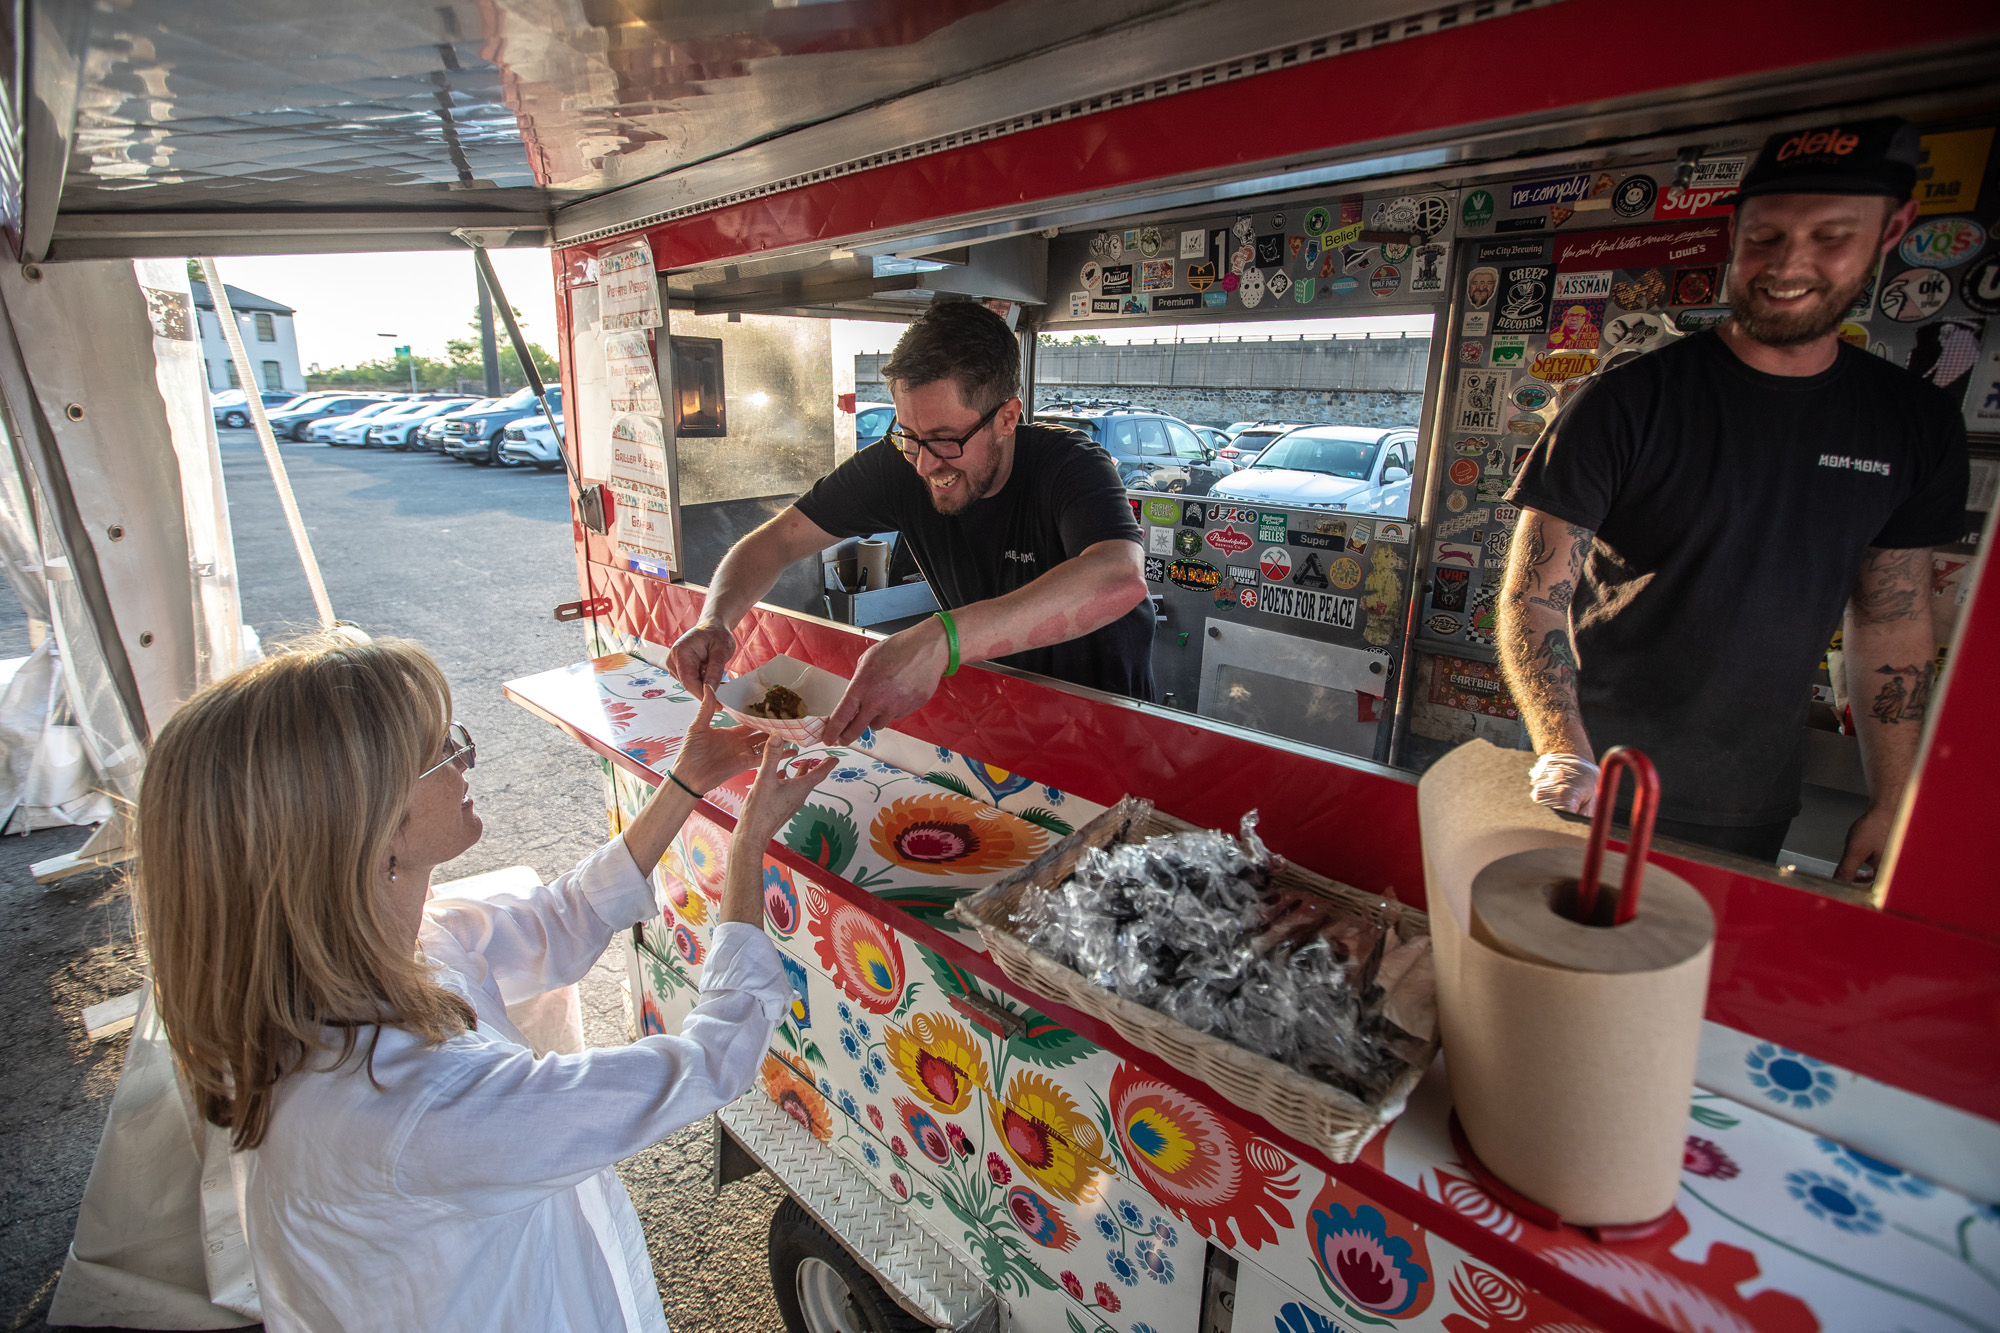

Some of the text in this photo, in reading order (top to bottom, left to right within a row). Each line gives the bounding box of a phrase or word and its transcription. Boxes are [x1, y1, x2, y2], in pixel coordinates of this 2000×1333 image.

[1776, 127, 1860, 162] ciele
[1717, 162, 1744, 173] STREET
[1617, 236, 1642, 251] better
[1480, 244, 1543, 259] Love City Brewing
[1669, 244, 1706, 260] LOWE'S
[1103, 270, 1130, 286] QUALITY
[1508, 267, 1549, 282] CREEP
[1563, 278, 1609, 295] ASSMAN
[1918, 280, 1944, 294] OK
[1094, 301, 1118, 310] REGULAR
[1158, 297, 1194, 307] Premium
[1496, 315, 1544, 330] RECORDS
[1581, 324, 1593, 333] MY
[1577, 331, 1599, 340] FRIEND
[1564, 339, 1598, 349] MY FRIEND
[1531, 351, 1601, 375] Serenity
[1544, 372, 1570, 383] now
[1462, 411, 1496, 428] HATE
[1210, 532, 1249, 547] Philadelphia
[1259, 531, 1284, 543] HELLES
[1301, 534, 1329, 547] Super
[1438, 568, 1467, 582] LVAC
[1261, 585, 1355, 627] POETS FOR PEACE
